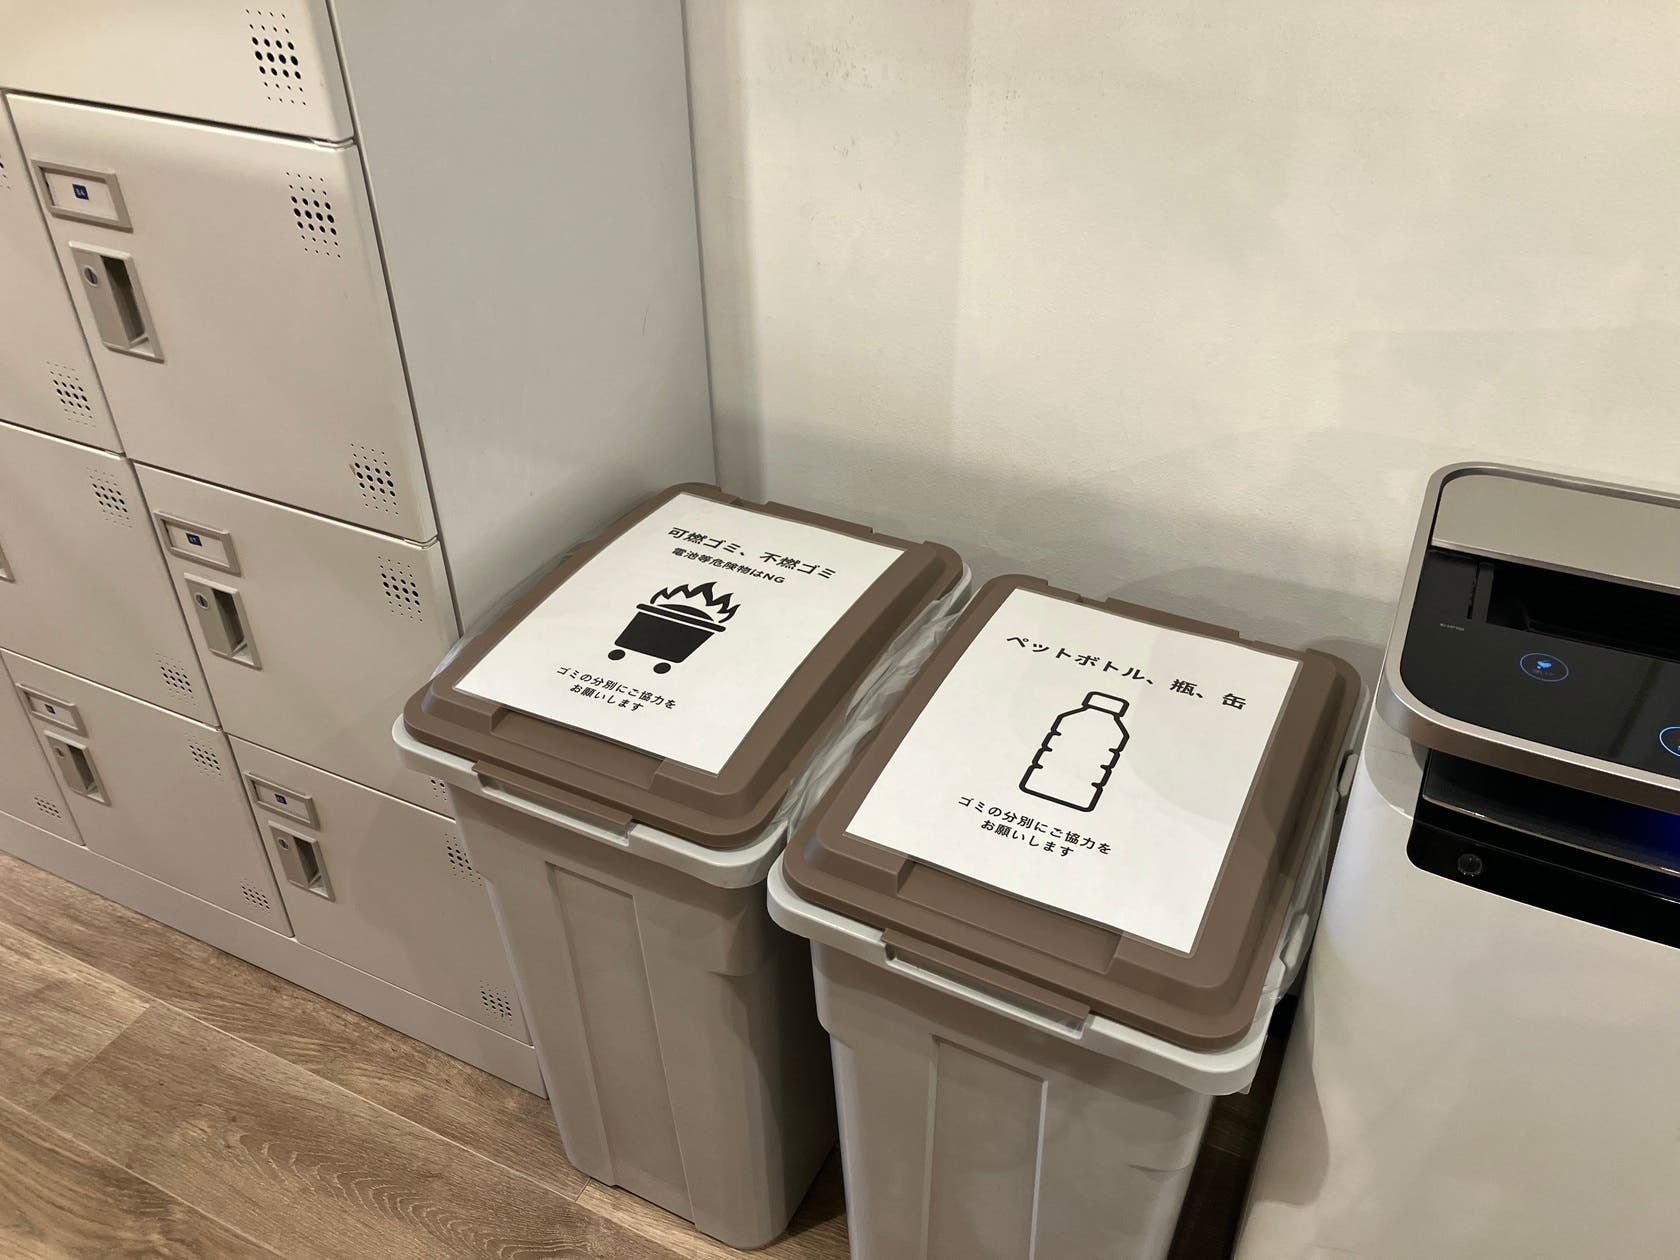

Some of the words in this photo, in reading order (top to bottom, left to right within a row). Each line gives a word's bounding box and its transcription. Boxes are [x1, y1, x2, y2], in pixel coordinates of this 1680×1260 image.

[672, 547, 786, 584] 電池等危険物はNG
[557, 666, 676, 710] ゴミの分別にご協力を
[570, 684, 644, 712] お願いします
[959, 796, 1112, 855] ゴミの分別にご協力を
[981, 821, 1075, 857] お願いします
